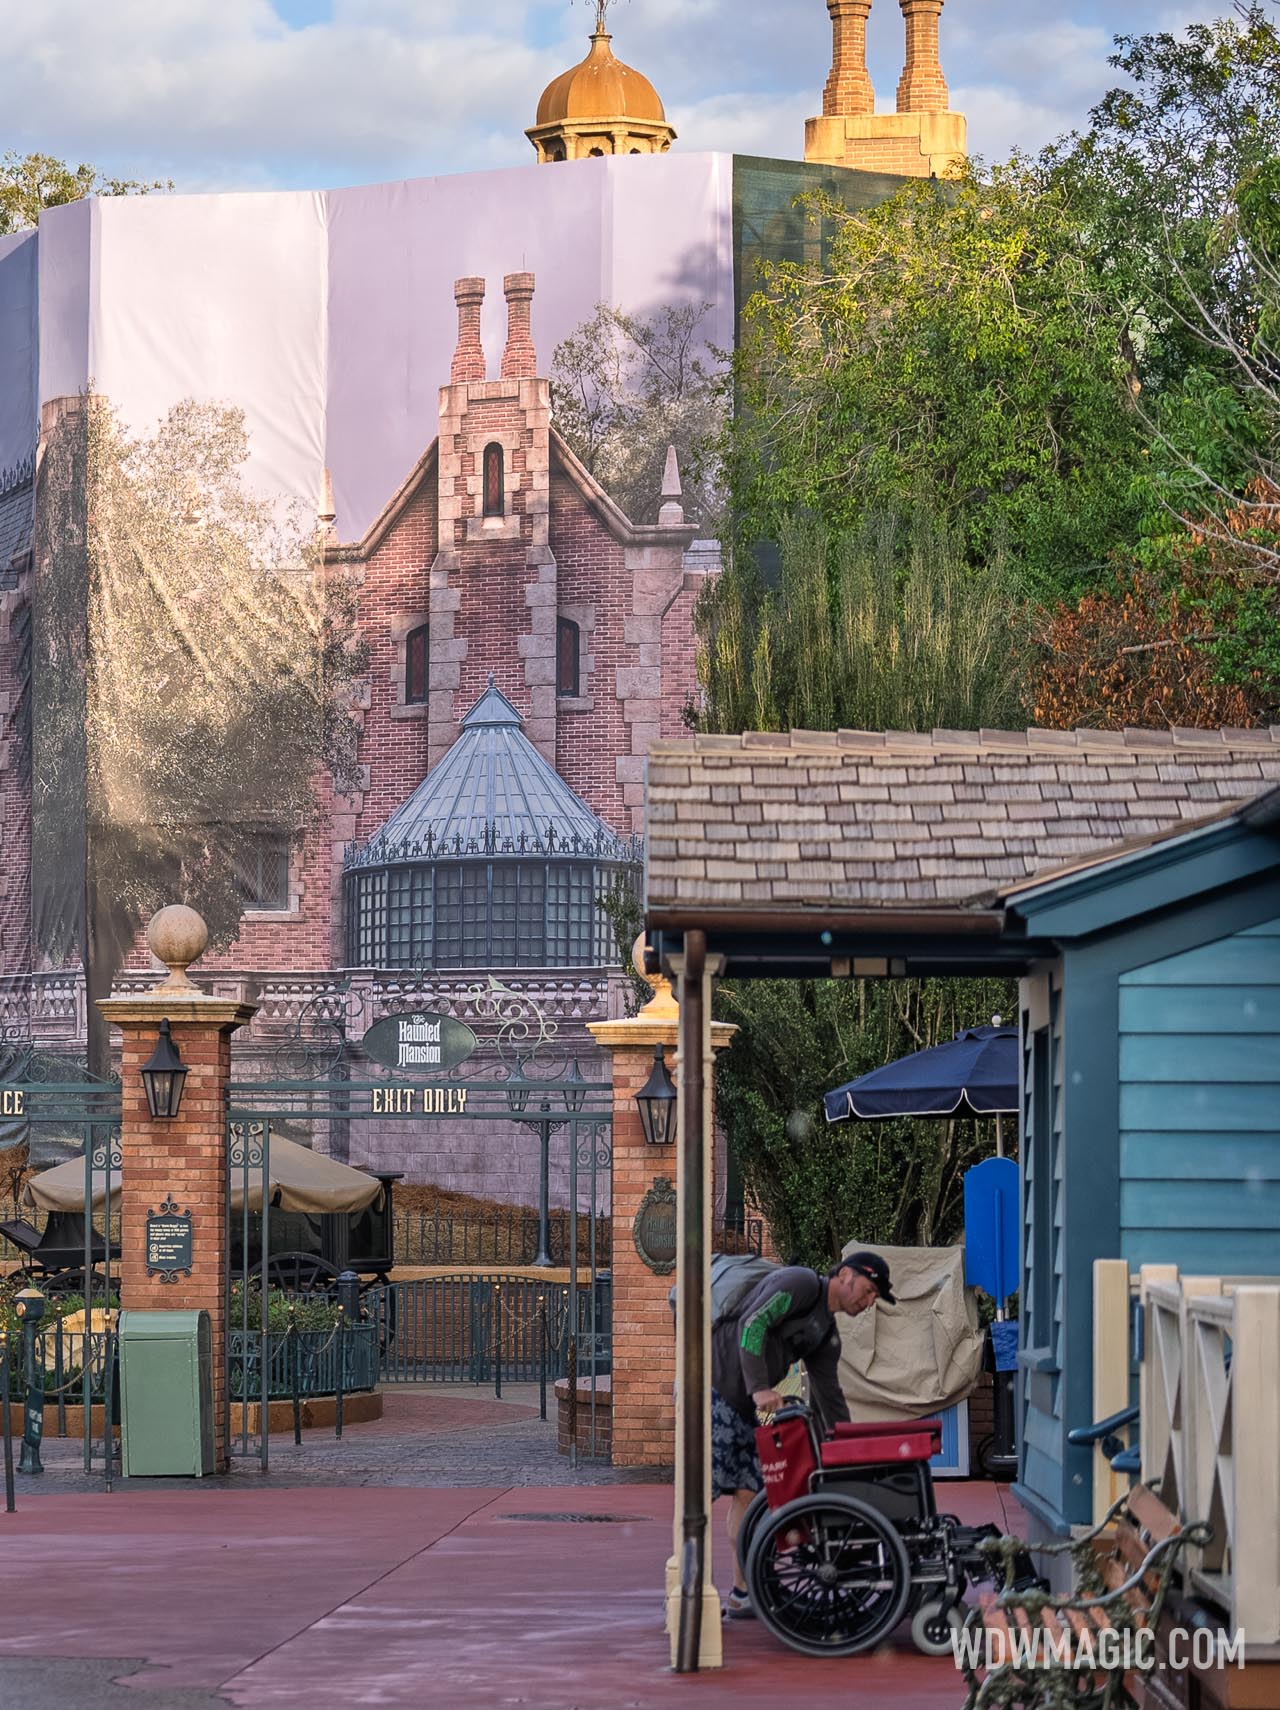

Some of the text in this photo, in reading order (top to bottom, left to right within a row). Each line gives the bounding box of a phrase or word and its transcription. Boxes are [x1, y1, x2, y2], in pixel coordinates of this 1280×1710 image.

[399, 1020, 440, 1041] Haunted
[397, 1043, 440, 1067] Mansion
[373, 1089, 467, 1112] EXIT ONLY
